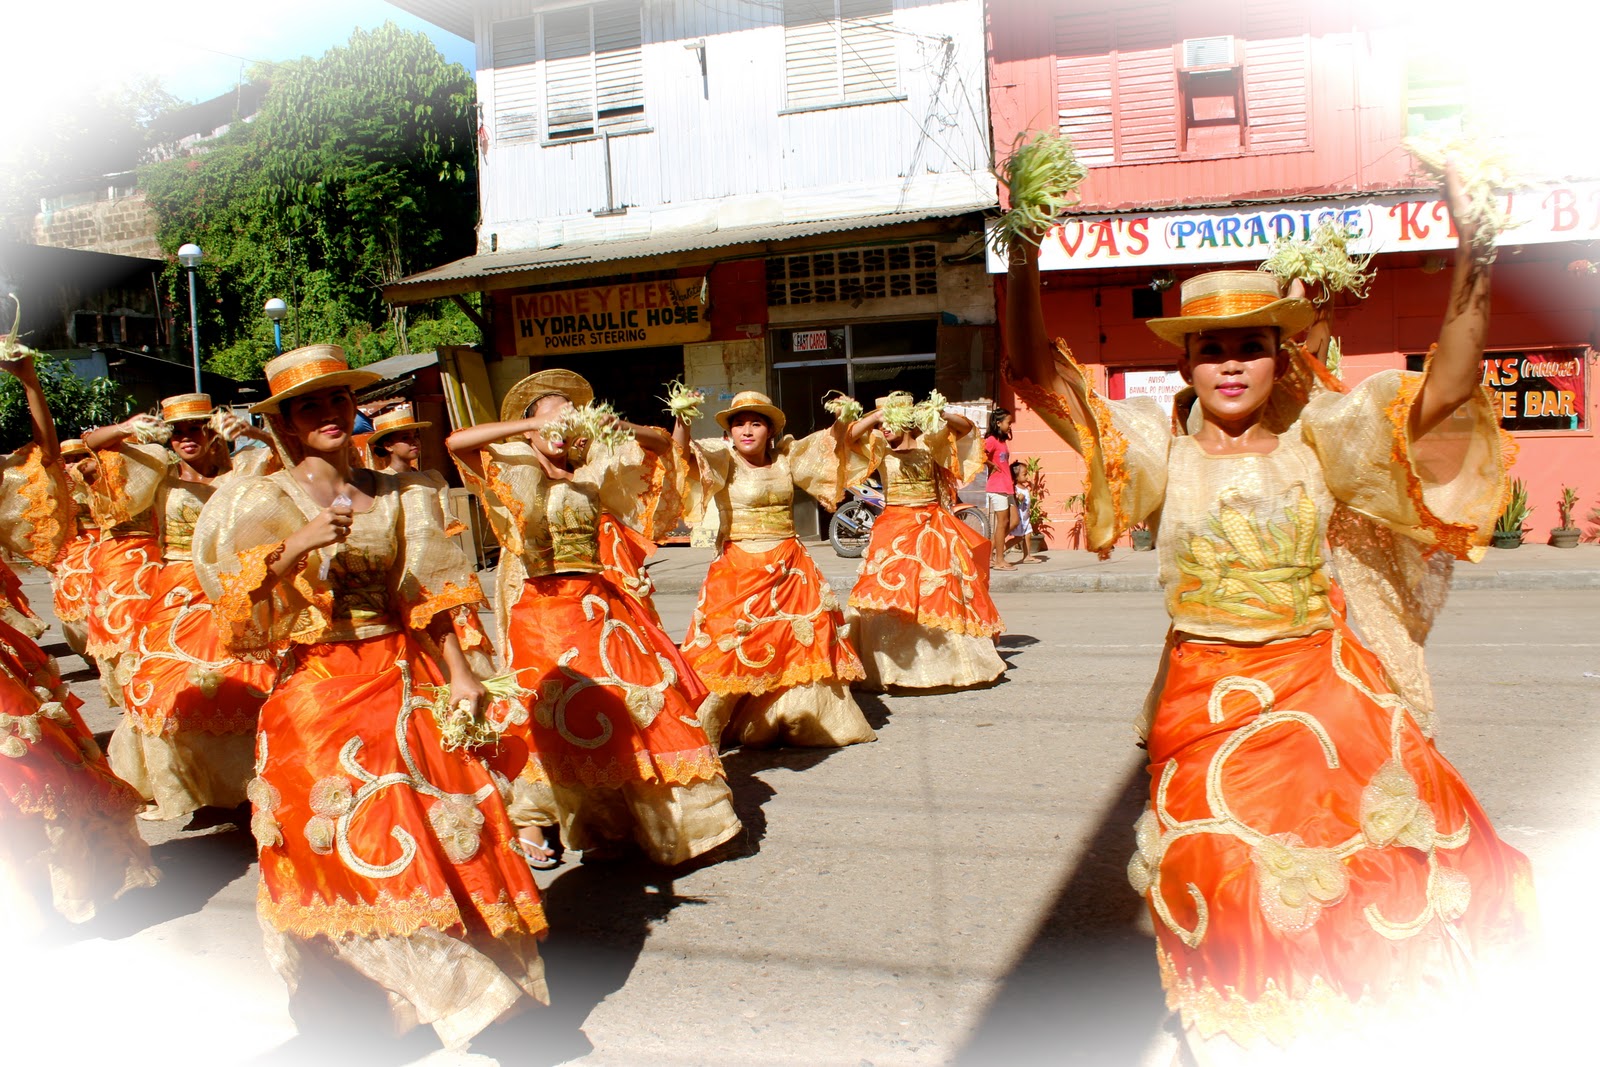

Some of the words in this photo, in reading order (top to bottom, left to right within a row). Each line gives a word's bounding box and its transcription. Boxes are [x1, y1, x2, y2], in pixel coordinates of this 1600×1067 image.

[1037, 217, 1150, 259] VA'S
[1541, 188, 1600, 232] B
[520, 310, 639, 338] HYDRAULIC
[646, 305, 699, 327] HOSE
[544, 334, 587, 349] POWER
[590, 328, 647, 346] STEERING
[1478, 358, 1519, 387] A'S
[1523, 390, 1578, 417] BAR
